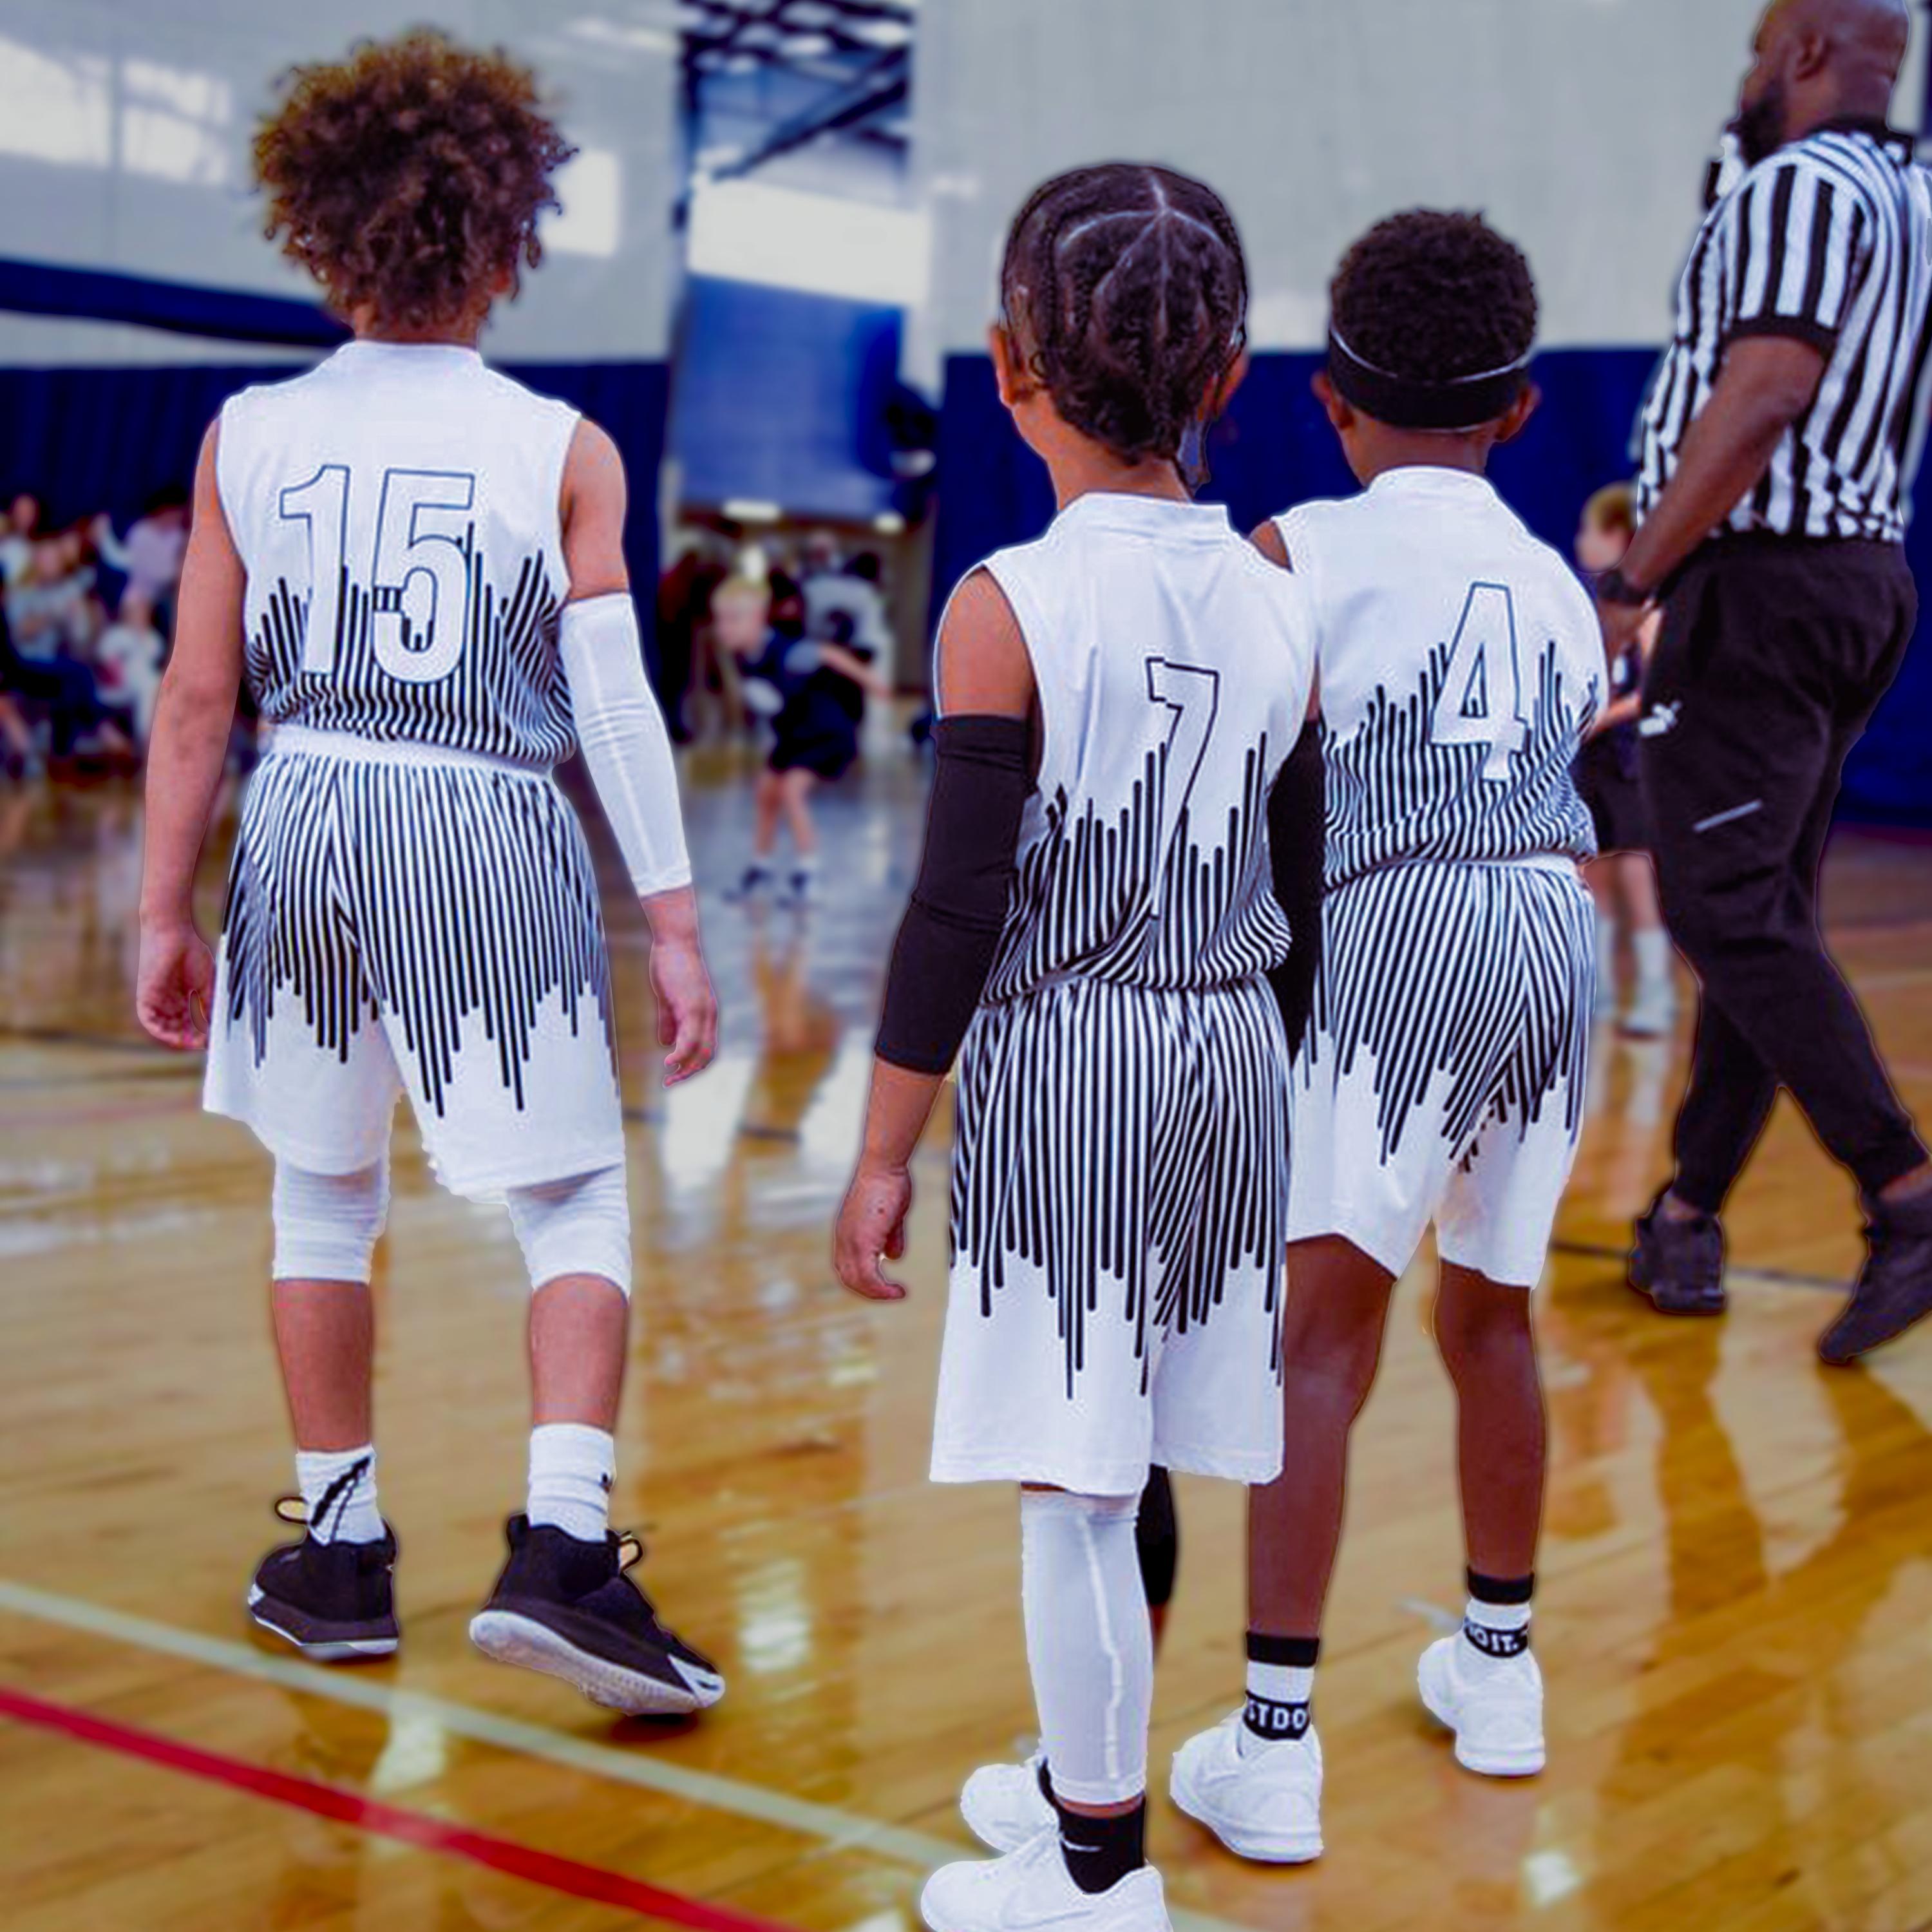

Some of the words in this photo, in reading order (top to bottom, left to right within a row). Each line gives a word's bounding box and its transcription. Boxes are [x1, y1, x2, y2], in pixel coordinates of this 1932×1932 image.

[279, 464, 475, 685] 15
[1428, 582, 1528, 783] 4
[1146, 656, 1219, 920] 7
